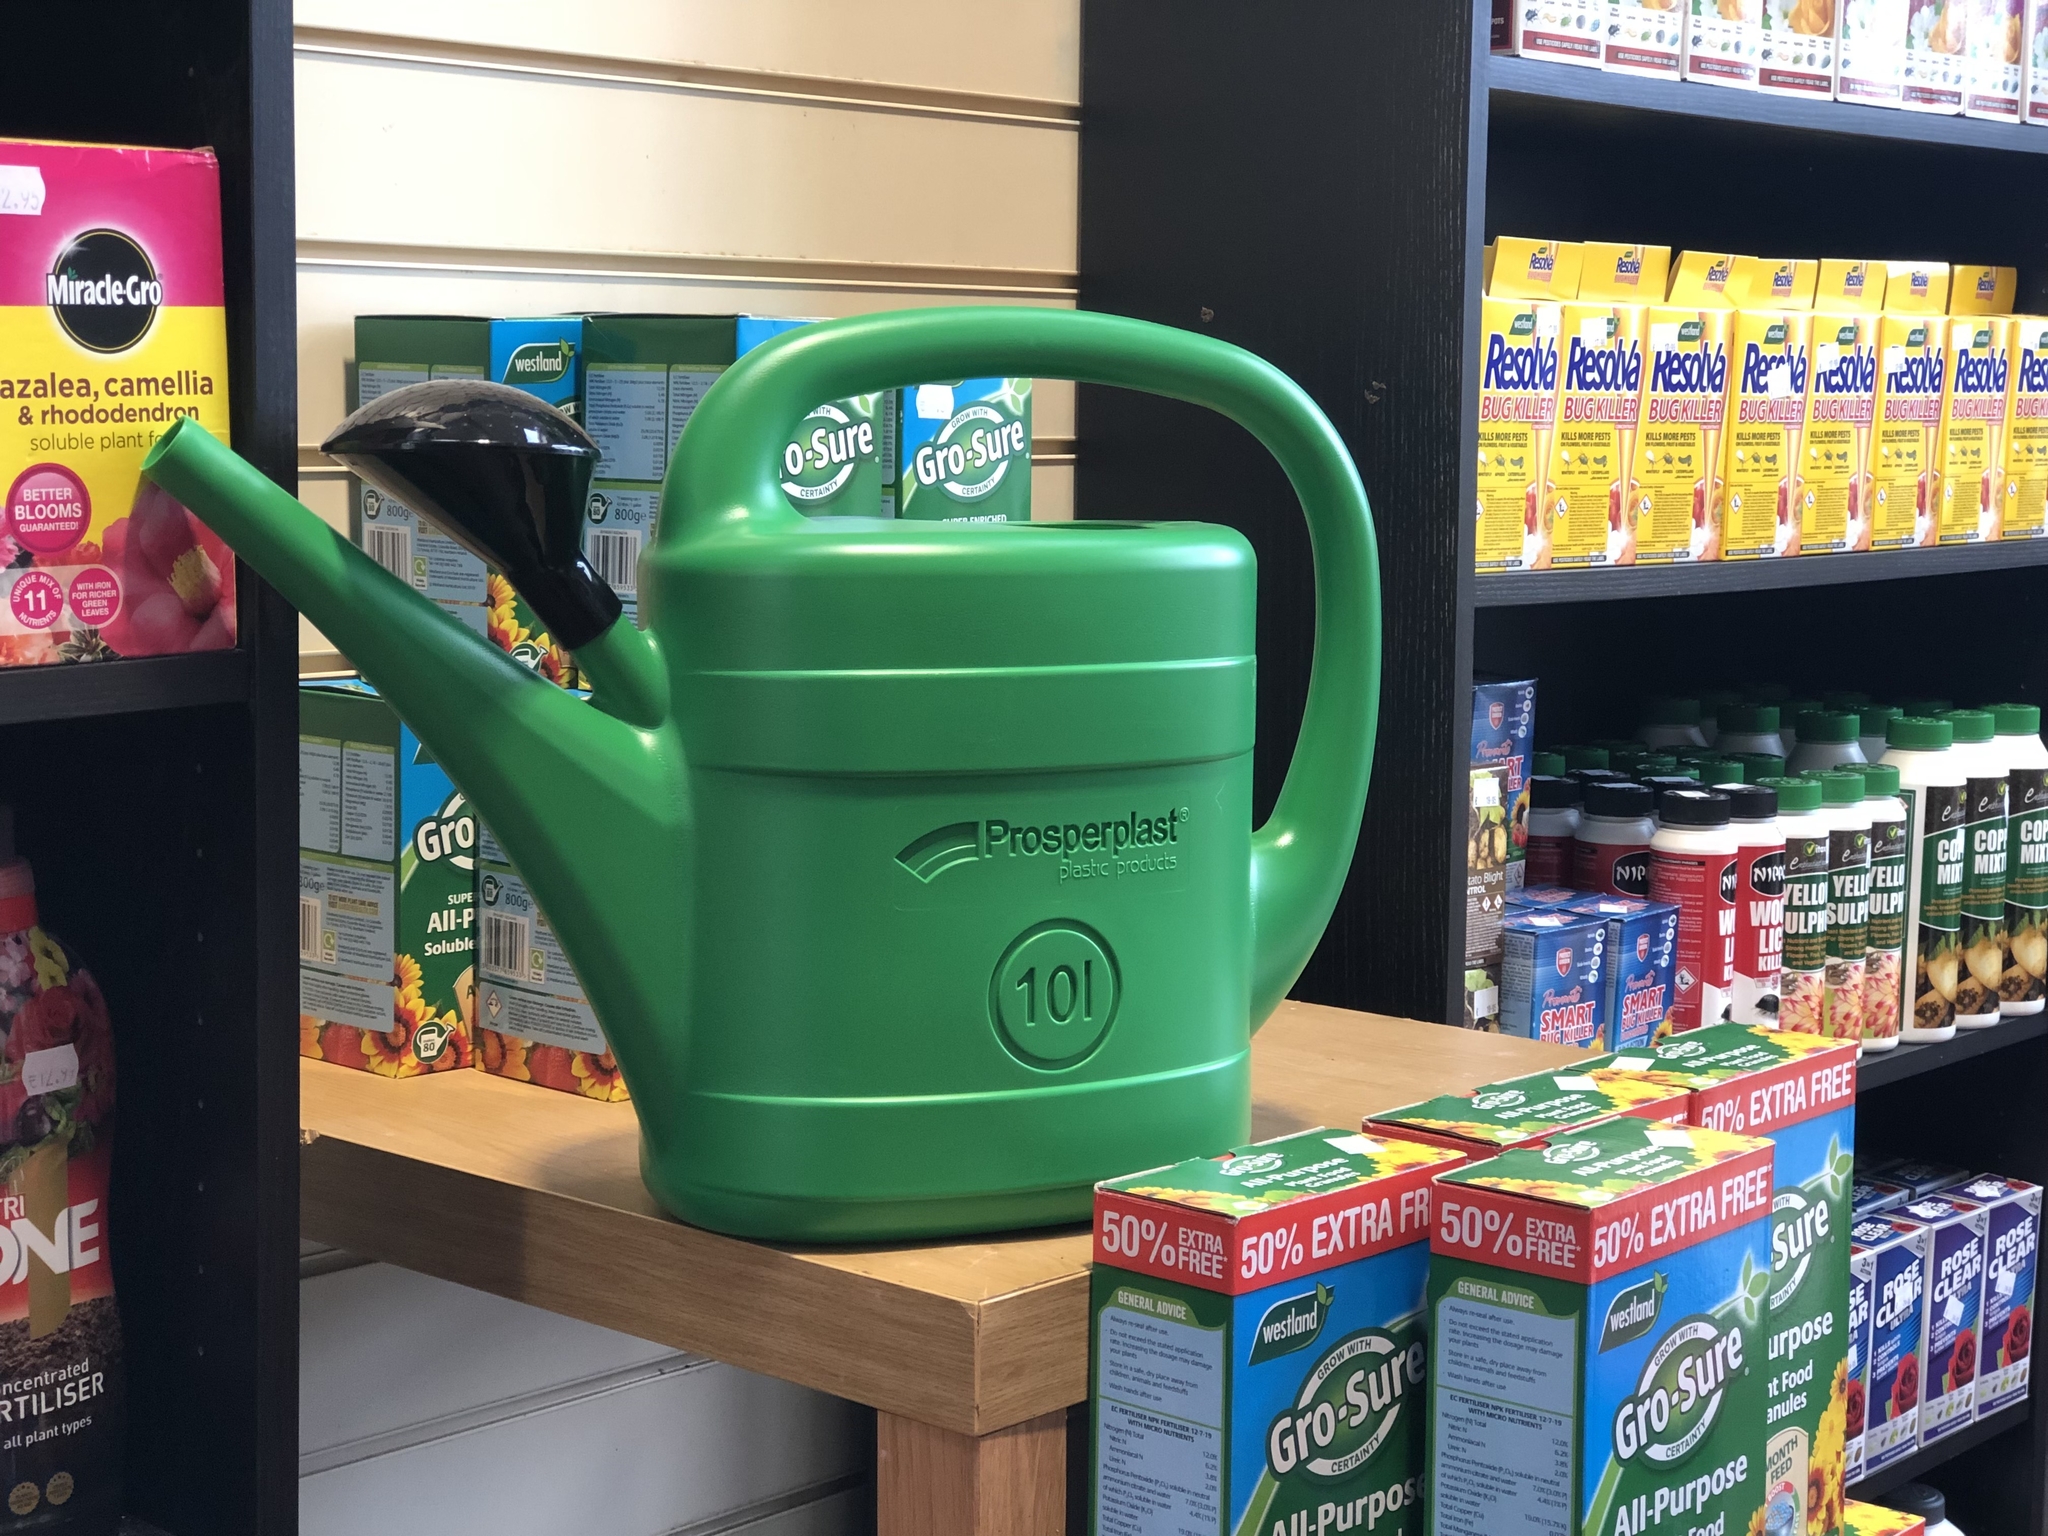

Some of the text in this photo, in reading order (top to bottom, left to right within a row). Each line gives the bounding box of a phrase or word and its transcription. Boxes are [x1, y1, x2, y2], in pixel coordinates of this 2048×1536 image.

[1616, 256, 1640, 274] Resolva
[515, 348, 562, 372] westland
[1484, 333, 1558, 391] Resolva
[1566, 337, 1641, 392] Resolva
[1954, 348, 2007, 393] Resolva
[0, 370, 214, 402] azalea, camellia
[18, 402, 200, 426] & rhododendron
[814, 406, 831, 416] WITH
[951, 408, 988, 429] GROW WITH
[1481, 396, 1553, 420] BUG KILLER
[1564, 397, 1637, 421] BUG KILLER
[1649, 399, 1722, 421] BUG KILLER
[1739, 400, 1803, 421] BUG KILLER
[1813, 400, 1872, 419] BUG KILLER
[1885, 400, 1940, 419] BUG KILLER
[1952, 399, 2003, 418] BUG KILLER
[30, 432, 144, 452] soluble plant
[1495, 433, 1511, 441] MORE
[1512, 433, 1528, 441] PESTS
[1561, 432, 1610, 441] KILLS MORE PESTS
[1646, 432, 1696, 441] KILLS MORE PESTS
[1736, 432, 1780, 441] KILLS MORE PESTS
[916, 420, 1025, 486] Gro-Sure
[23, 488, 72, 501] BETTER
[800, 479, 838, 498] CERTAINTY
[961, 477, 995, 495] CERTAINTY
[15, 503, 82, 520] BLOOMS
[19, 522, 79, 532] GUARANTEED!
[13, 575, 61, 602] UNIQUE MIX OF
[24, 589, 46, 611] 11
[89, 590, 116, 598] RICHER
[82, 600, 107, 608] GREEN
[82, 608, 109, 617] LEAVES
[19, 610, 57, 626] NUTRIENTS
[1060, 851, 1177, 884] plastic products
[1483, 871, 1503, 885] Blight
[1754, 865, 1785, 882] NIPP
[1783, 882, 1828, 906] YELLO
[424, 937, 475, 956] Soluble
[1759, 926, 1783, 953] LIC
[1623, 984, 1666, 1016] SMART
[1541, 1001, 1595, 1033] SMART
[1621, 1006, 1663, 1031] BUG KILLER
[1540, 1024, 1594, 1042] BUG KILLER
[423, 1042, 435, 1052] 80
[1682, 1045, 1761, 1067] All-Purpose
[1495, 1094, 1586, 1119] All-Purpose
[1701, 1100, 1745, 1131] 50%
[1749, 1075, 1806, 1126] EXTRA
[1219, 1153, 1284, 1176] Gro-Sure
[1544, 1141, 1597, 1164] Gro-Sure
[1572, 1145, 1664, 1176] All-Purpose
[1240, 1158, 1349, 1188] All-Purpose
[1284, 1167, 1352, 1186] Plant Food
[1614, 1155, 1672, 1175] Plant Food
[1636, 1160, 1684, 1176] Granules
[1305, 1172, 1361, 1187] Granules
[1774, 1196, 1790, 1209] WITH
[1102, 1209, 1223, 1267] 50% EXTRA
[1241, 1187, 1432, 1279] 50% EXTRA FR
[1440, 1202, 1576, 1257] 50% EXTRA
[1594, 1211, 1644, 1268] 50%
[1650, 1186, 1715, 1246] EXTRA
[1996, 1216, 2033, 1257] ROSE
[1941, 1237, 1979, 1280] ROSE
[1988, 1232, 2035, 1280] CLEAR
[1883, 1259, 1920, 1304] ROSE
[1934, 1254, 1982, 1303] CLEAR
[1117, 1290, 1187, 1321] GENERAL ADVICE
[1458, 1281, 1534, 1309] GENERAL ADVICE
[1263, 1301, 1318, 1345] westland
[1449, 1305, 1468, 1315] Always
[1469, 1310, 1487, 1319] re-seal
[1610, 1289, 1655, 1333] westland
[1469, 1323, 1489, 1333] exceed
[1501, 1331, 1519, 1339] stated
[1521, 1335, 1553, 1347] application
[1654, 1324, 1699, 1367] GROW WITH
[1769, 1311, 1833, 1360] urpose
[1317, 1339, 1371, 1381] GROW WITH
[1782, 1359, 1813, 1392] Food
[1615, 1327, 1743, 1460] Gro-Sure
[1270, 1340, 1425, 1474] Gro-Sure
[1459, 1396, 1490, 1410] FERTILISER
[1491, 1405, 1503, 1413] NPK
[1505, 1408, 1537, 1420] FERTILISER
[1468, 1407, 1542, 1430] WITH MICRO NUTRIENTS
[1767, 1391, 1807, 1424] anules
[3, 1415, 93, 1450] all plant types
[1666, 1420, 1706, 1459] CERTAINTY
[1331, 1433, 1381, 1474] CERTAINTY
[1770, 1460, 1793, 1485] FEED
[1614, 1453, 1748, 1536] All-Purpose
[1768, 1482, 1785, 1499] BOOST
